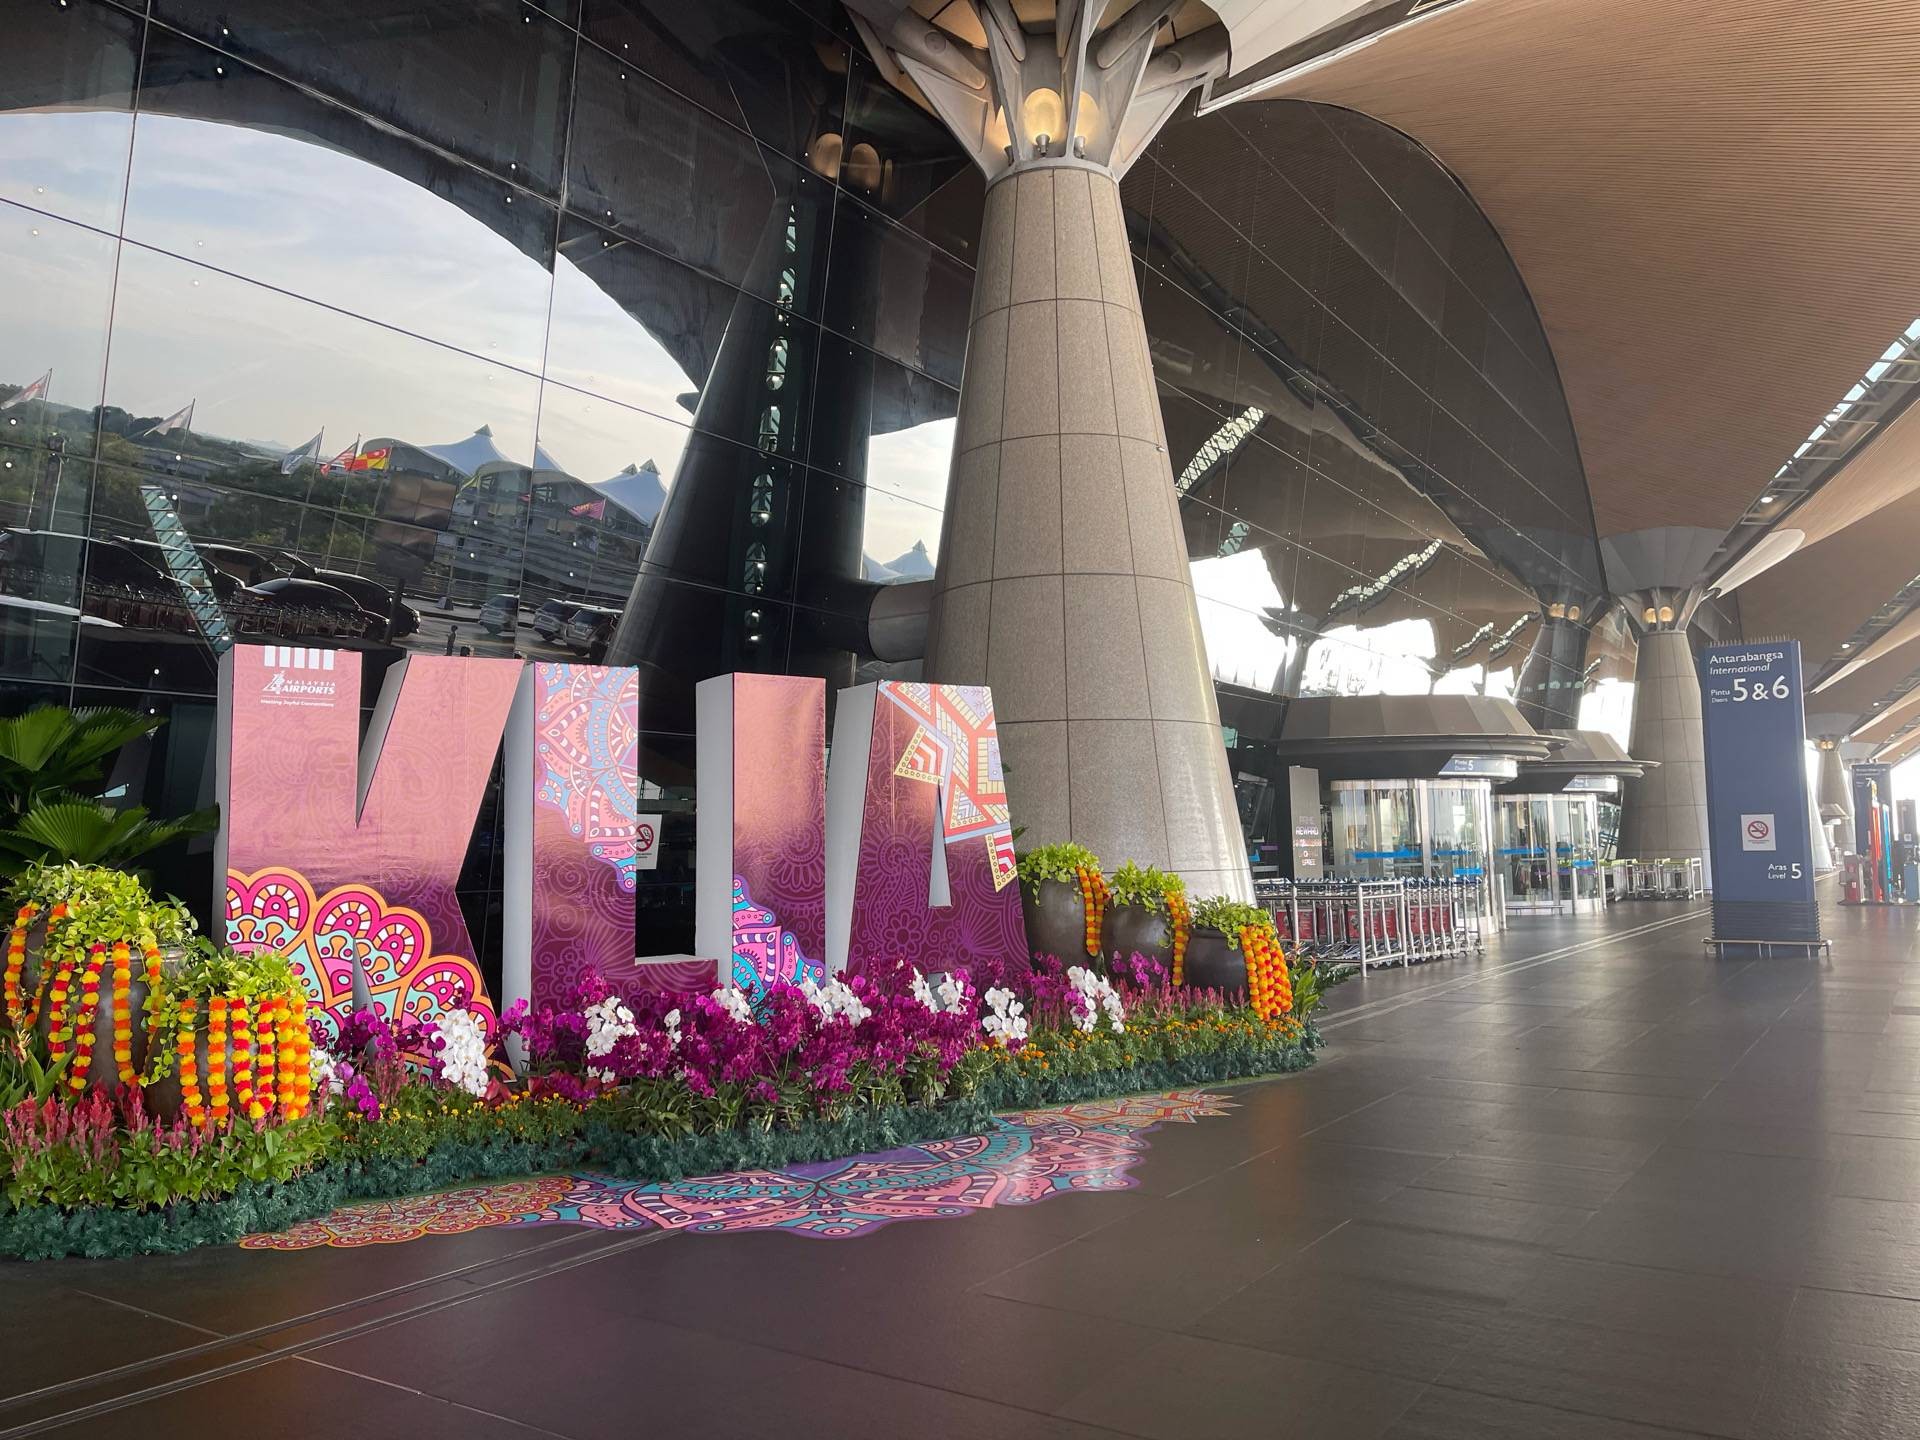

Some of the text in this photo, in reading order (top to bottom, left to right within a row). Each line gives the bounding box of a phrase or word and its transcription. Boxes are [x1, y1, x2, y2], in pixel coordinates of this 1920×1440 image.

[1709, 652, 1783, 664] Antarabangsa
[1709, 663, 1770, 675] International
[286, 679, 336, 687] MALAYSIA
[1710, 675, 1790, 701] Pintu 5 & 6
[282, 685, 335, 695] AIRPORTS
[1468, 760, 1474, 770] 5
[1768, 863, 1802, 879] Aras 5
